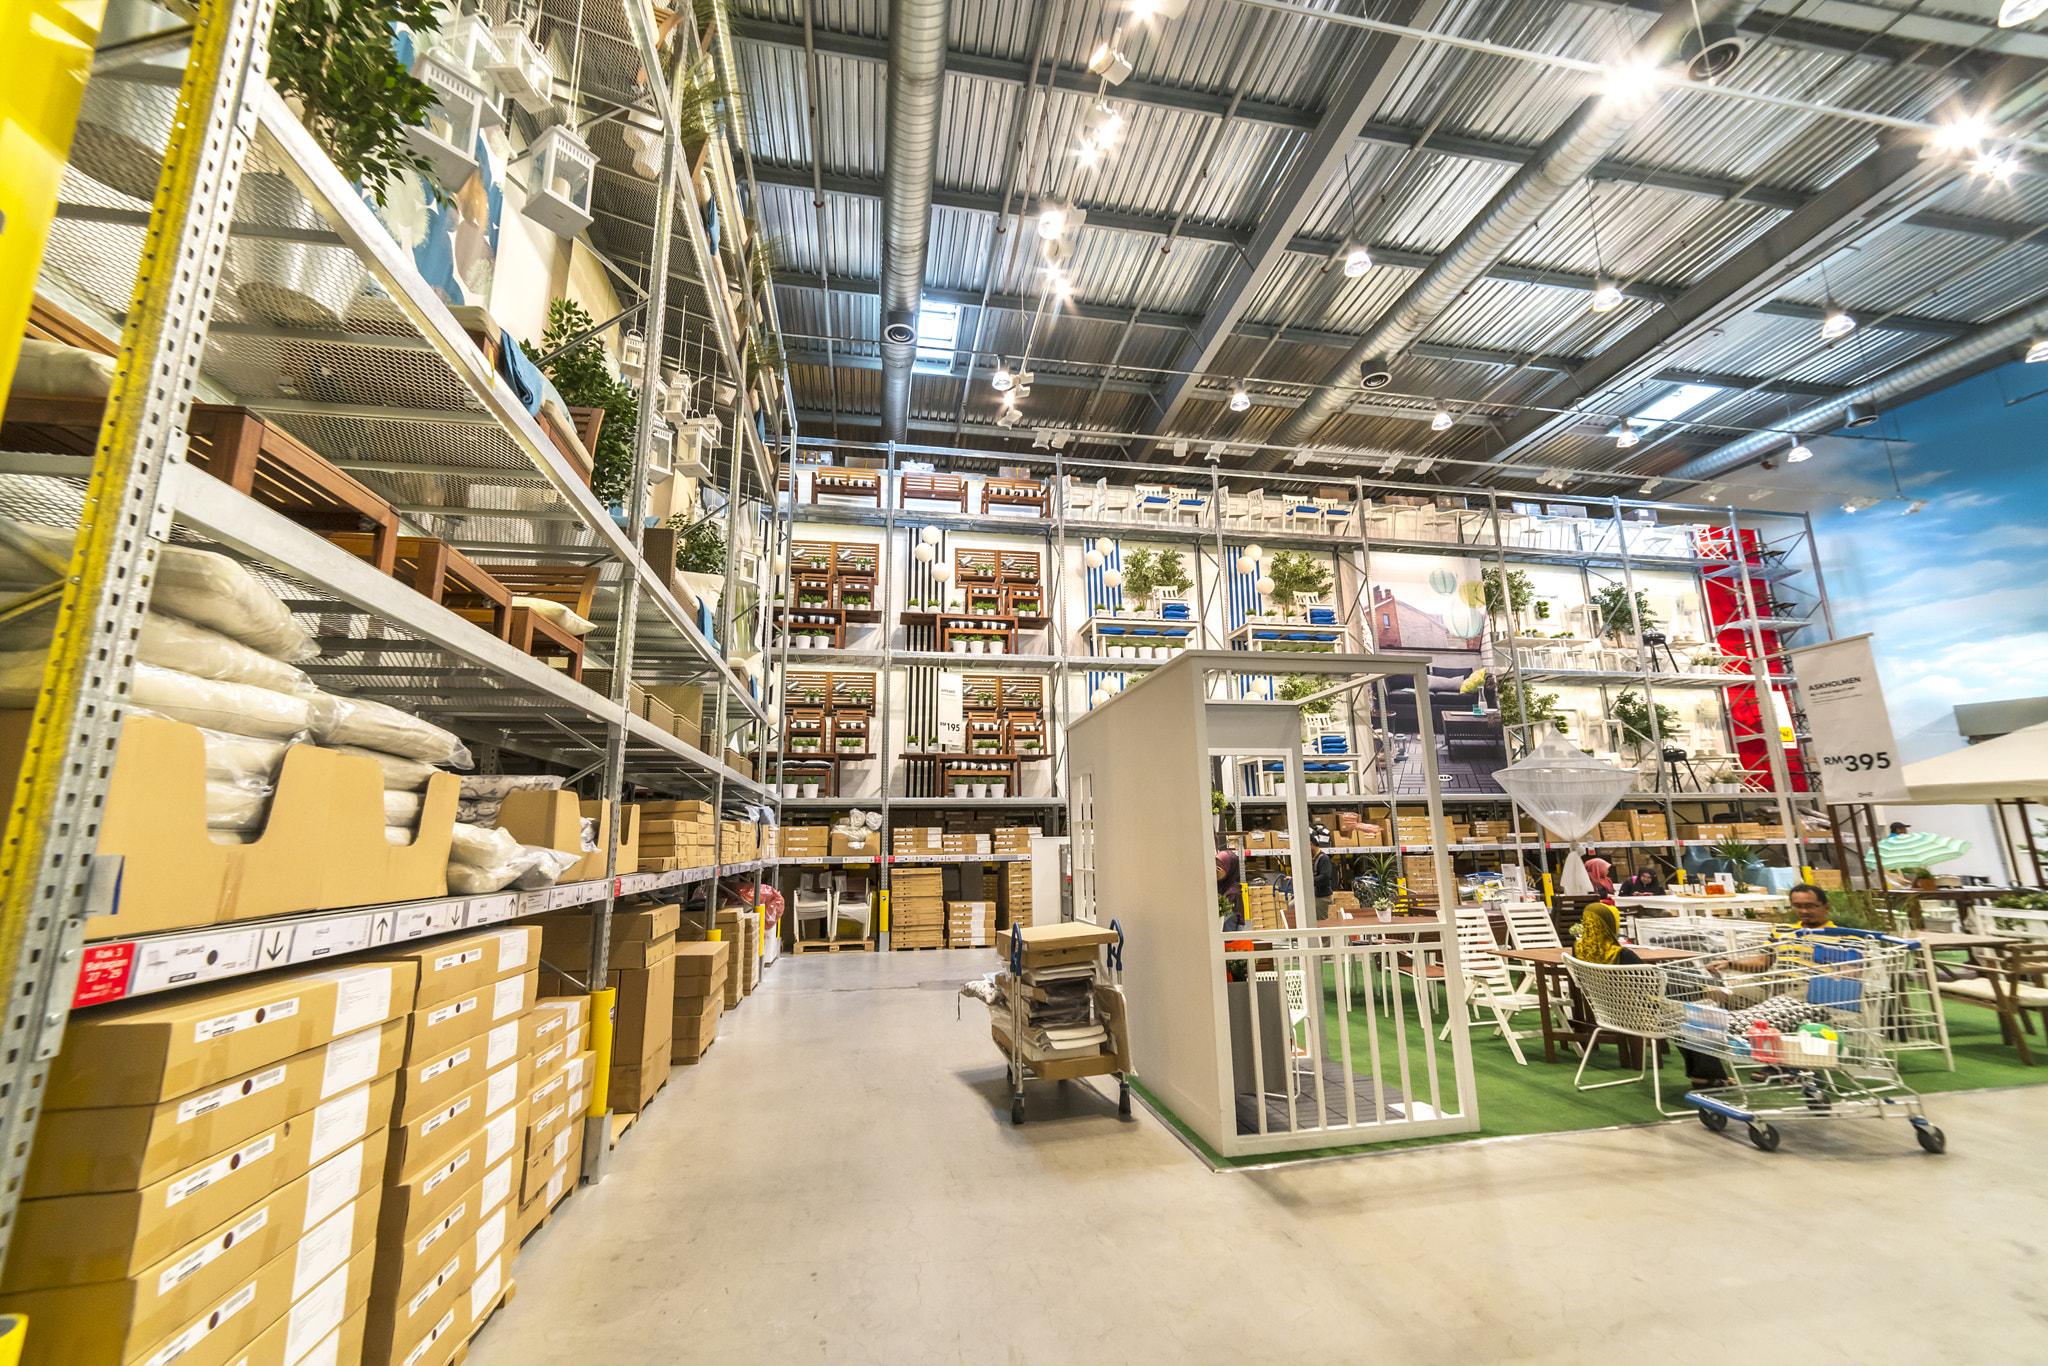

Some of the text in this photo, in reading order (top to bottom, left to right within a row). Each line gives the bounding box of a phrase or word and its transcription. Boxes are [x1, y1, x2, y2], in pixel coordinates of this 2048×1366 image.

[1808, 676, 1862, 691] ASKHOLMEN
[95, 947, 124, 960] Rak 3
